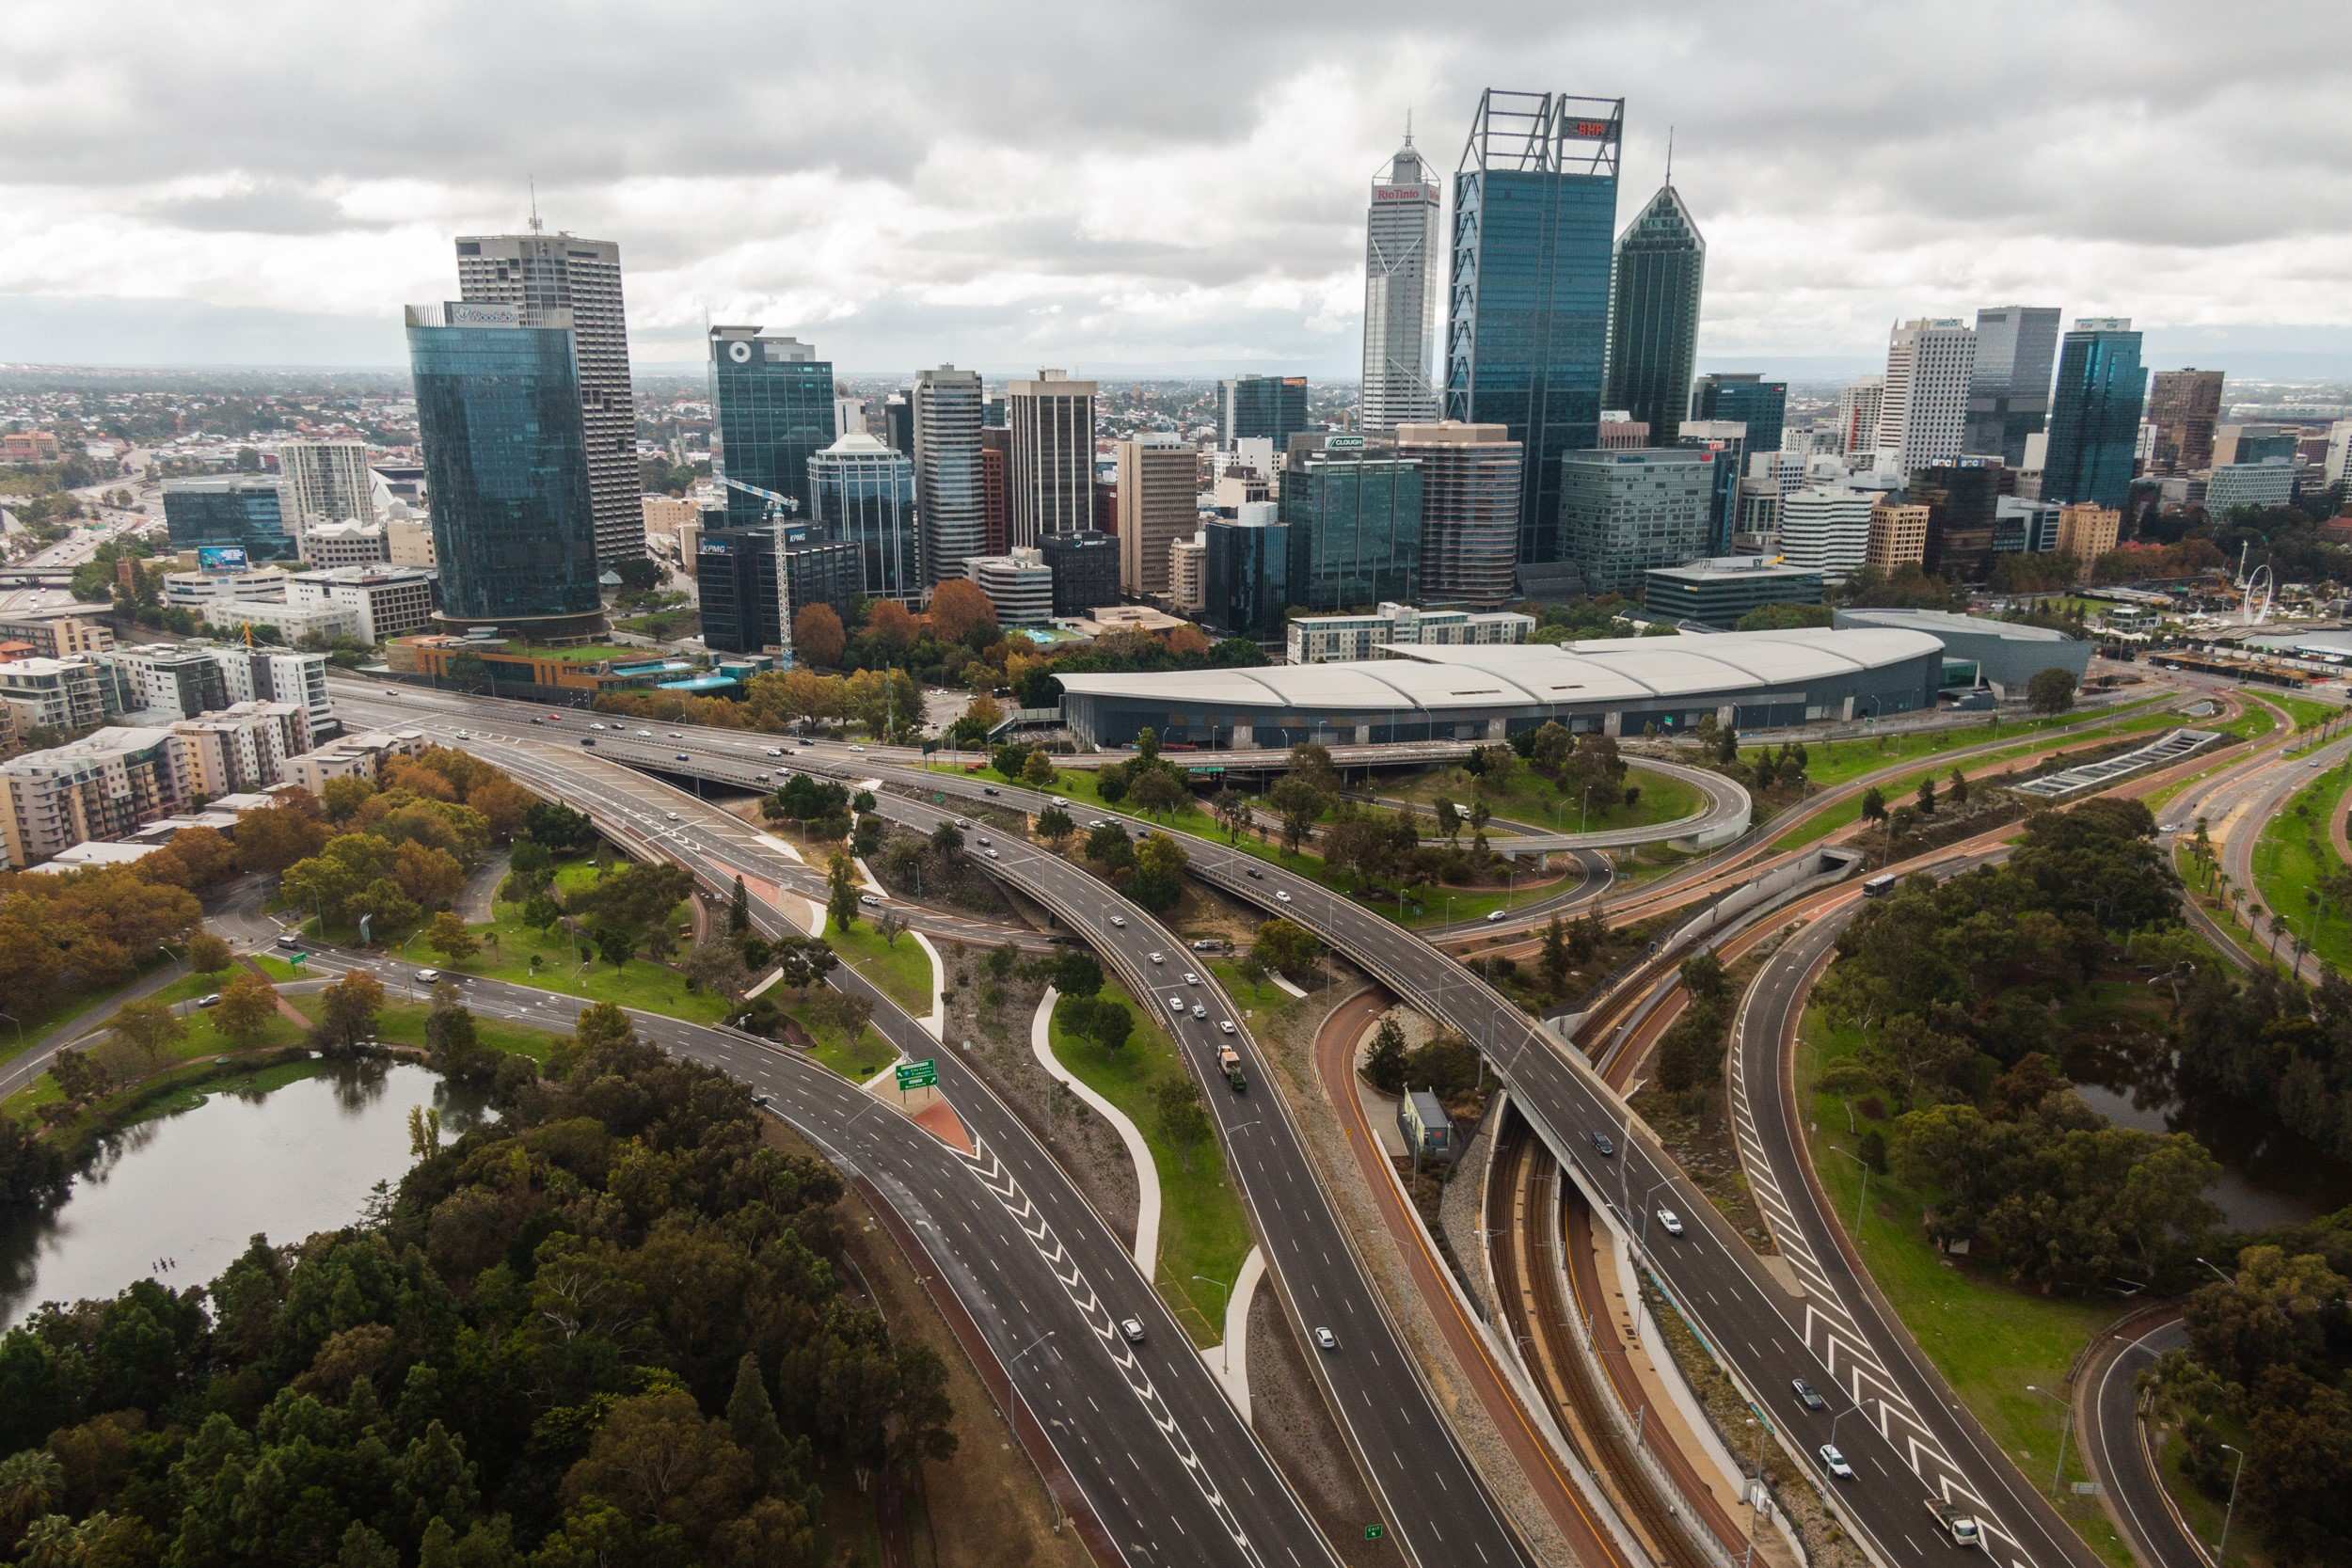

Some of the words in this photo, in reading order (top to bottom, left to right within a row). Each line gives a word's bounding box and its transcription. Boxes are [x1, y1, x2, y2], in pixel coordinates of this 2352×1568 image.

[1580, 123, 1605, 136] BHP
[790, 532, 806, 543] KPMG
[702, 545, 725, 553] KPMG
[1754, 559, 1762, 571] EY
